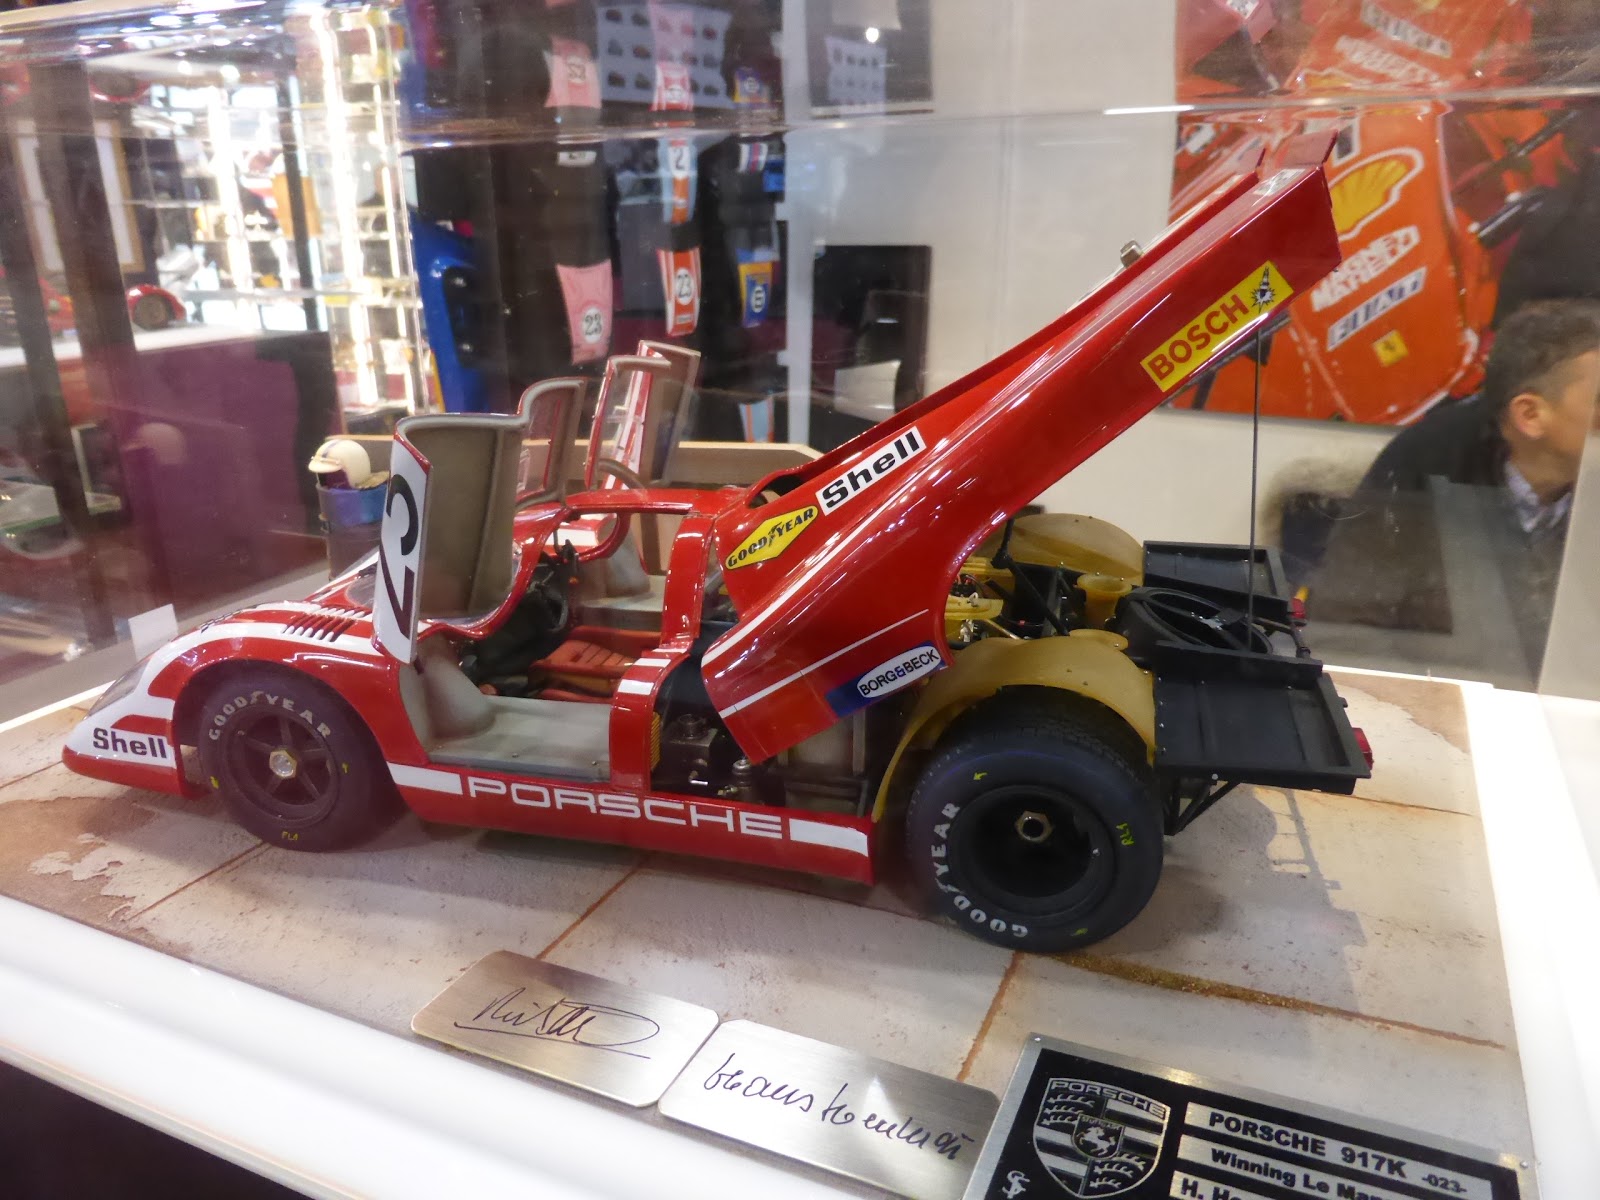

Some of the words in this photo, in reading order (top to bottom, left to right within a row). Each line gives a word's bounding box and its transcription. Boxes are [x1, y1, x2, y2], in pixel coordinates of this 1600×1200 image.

[1147, 294, 1250, 381] BOSCH
[821, 430, 921, 509] Shell
[858, 647, 940, 696] BORG&BECK
[92, 727, 168, 760] Shell
[468, 775, 784, 840] PORSCHE
[1050, 1080, 1167, 1120] PORSCHE
[1208, 1111, 1326, 1157] PORSCHE
[1340, 1146, 1407, 1179] 917K
[1181, 1177, 1204, 1200] H.
[1211, 1147, 1296, 1188] Winning
[1302, 1172, 1330, 1194] Le
